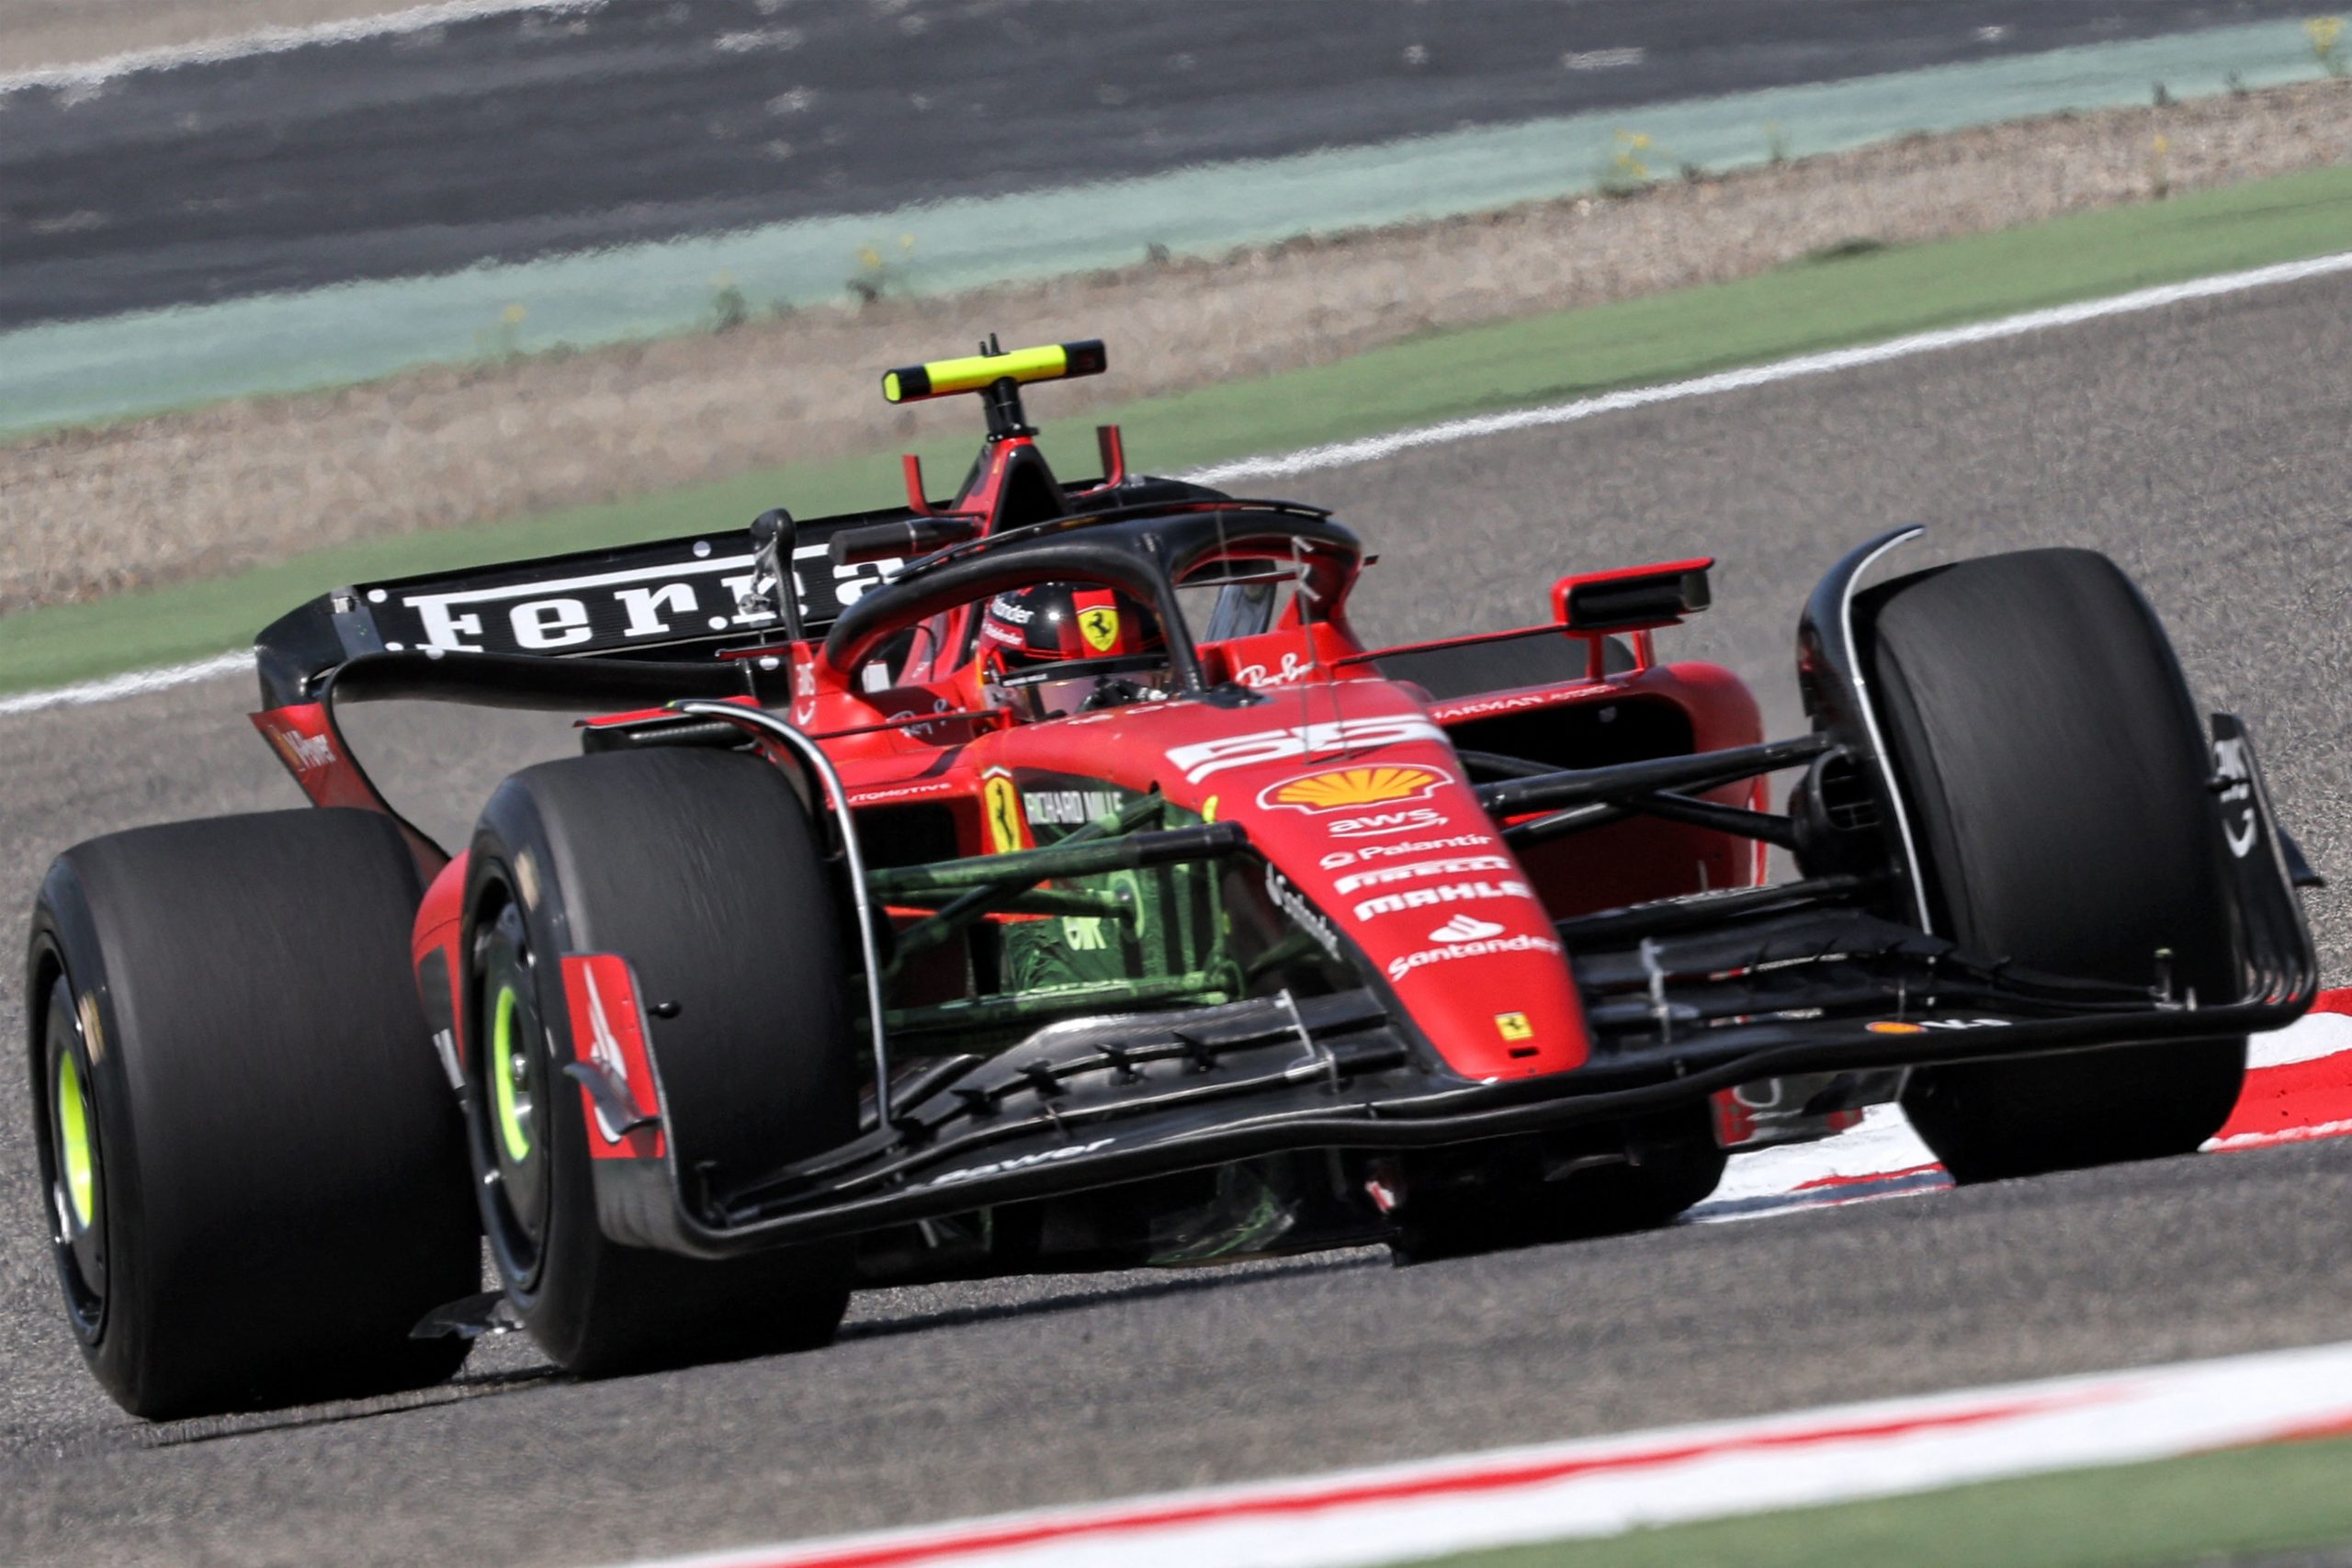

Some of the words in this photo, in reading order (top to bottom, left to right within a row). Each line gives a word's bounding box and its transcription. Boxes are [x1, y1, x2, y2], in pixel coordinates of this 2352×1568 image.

[1165, 715, 1450, 784] 55
[846, 783, 952, 803] UTOMOTIVE
[1023, 791, 1085, 824] RICHARD
[1327, 807, 1440, 833] aws
[1357, 834, 1493, 861] Palantir
[1333, 855, 1511, 896] PIRELLI
[1353, 880, 1534, 922] MAHLE
[1387, 934, 1561, 983] Santander
